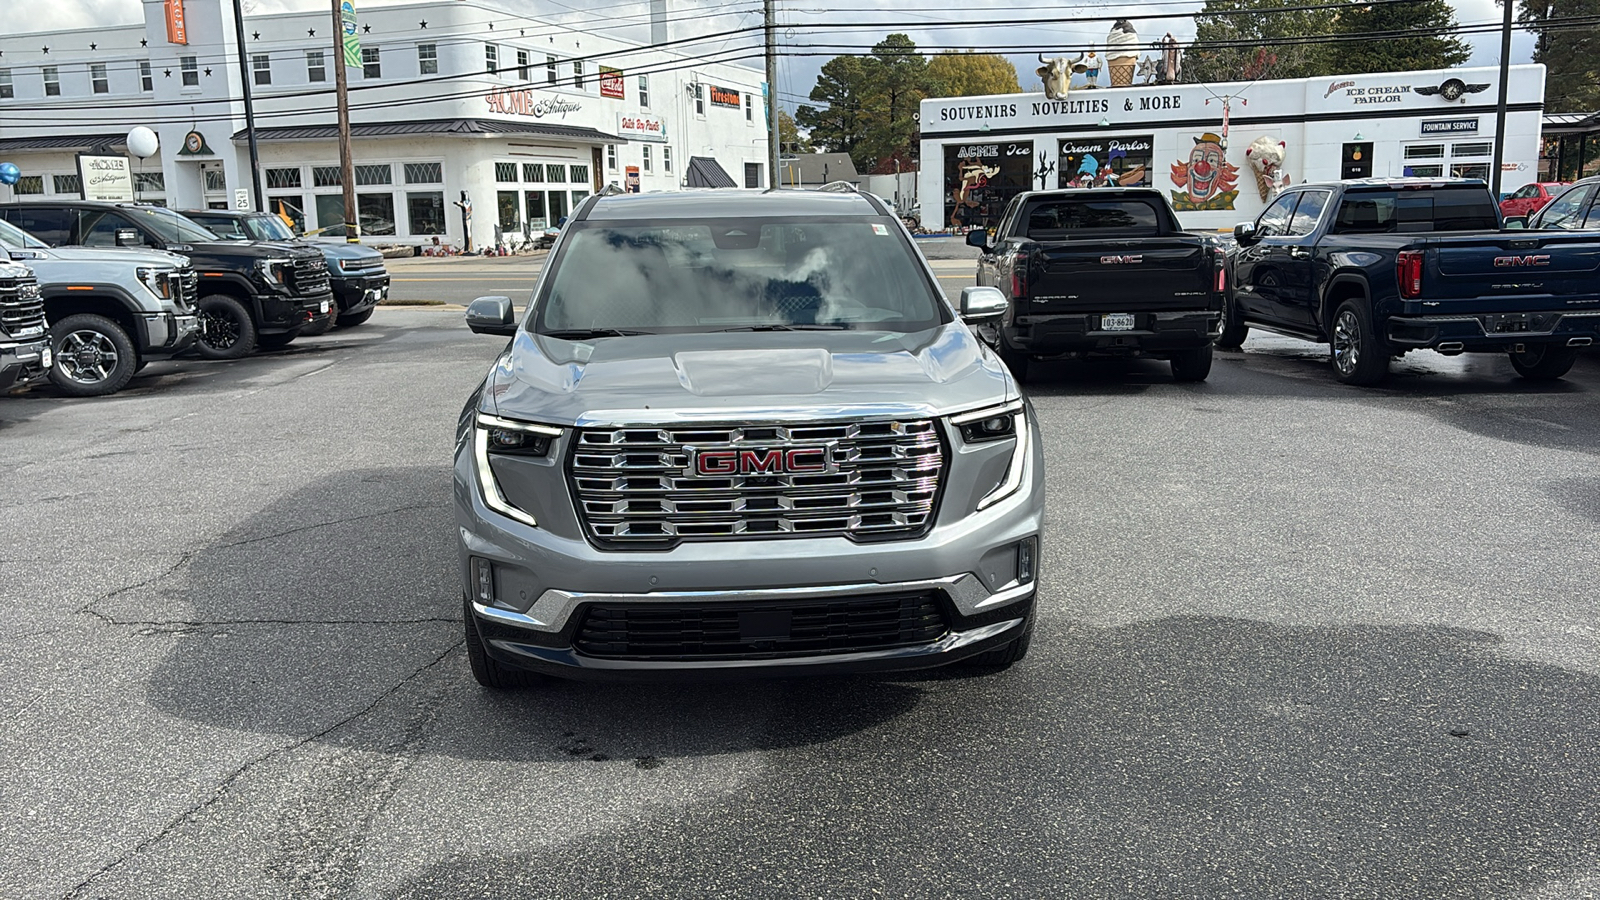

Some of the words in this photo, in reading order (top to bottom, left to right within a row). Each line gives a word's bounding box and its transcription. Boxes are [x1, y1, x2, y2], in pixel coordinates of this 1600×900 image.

[710, 86, 740, 105] Firestone
[1346, 88, 1365, 96] ICE
[1368, 85, 1411, 95] CREAM
[485, 85, 534, 116] ACME
[534, 94, 582, 119] Antiques
[1353, 95, 1401, 104] PARLOR
[940, 103, 1017, 120] SOUVENIRS
[1032, 99, 1109, 116] NOVELTIES
[1123, 97, 1133, 111] &
[1139, 95, 1181, 110] MORE
[622, 117, 634, 129] Dutch
[636, 118, 645, 133] Boy
[646, 119, 659, 131] Paints
[1423, 122, 1451, 132] FOUNTAIN
[1452, 121, 1476, 130] SERVICE
[957, 145, 999, 158] ACME
[1006, 144, 1031, 156] Ice
[1062, 141, 1103, 154] Cream
[1108, 140, 1151, 151] Parlor
[89, 159, 124, 170] ACME
[237, 199, 248, 208] 25
[1100, 254, 1143, 264] GMC
[1493, 254, 1551, 268] GMC
[697, 447, 825, 475] GMC
